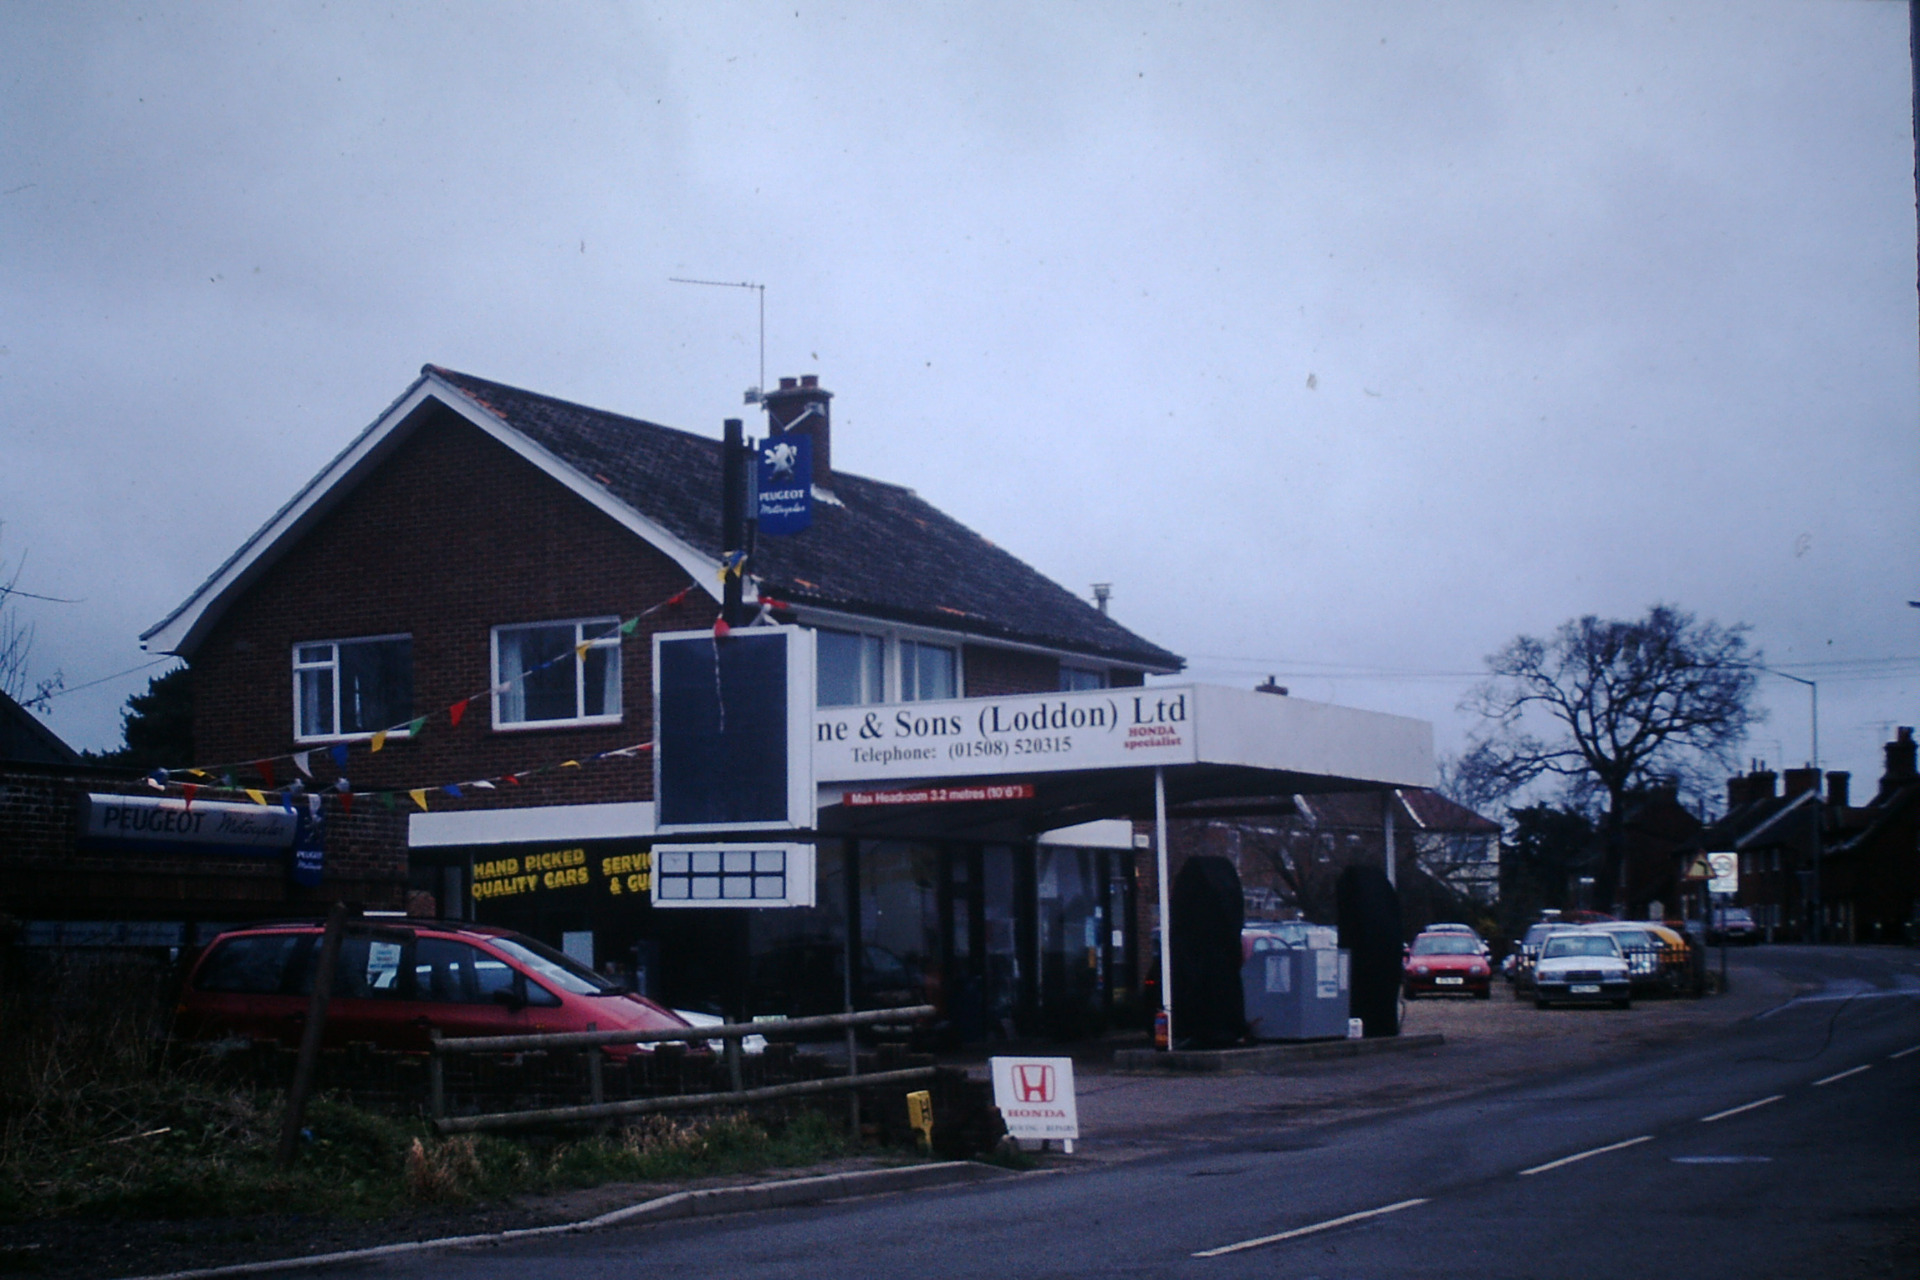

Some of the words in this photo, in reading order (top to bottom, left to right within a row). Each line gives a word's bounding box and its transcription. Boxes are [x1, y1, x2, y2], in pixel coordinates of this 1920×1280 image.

[759, 489, 804, 501] PEUGEOT
[816, 720, 849, 742] ne
[859, 711, 883, 739] &
[895, 710, 962, 738] Sons
[977, 698, 1119, 739] (Loddon)
[1132, 694, 1187, 724] Ltd
[1128, 725, 1176, 737] HONDA
[851, 745, 937, 766] Telephone:
[948, 739, 1010, 760] (01508)
[1014, 735, 1073, 754] 520315
[1123, 736, 1182, 750] specialist
[851, 793, 873, 804] Max
[875, 791, 928, 804] Headroom
[930, 789, 947, 801] 3.2
[949, 788, 985, 800] metres
[103, 806, 207, 834] PEUGEOT
[474, 858, 520, 880] HAND
[525, 849, 587, 872] PICKED
[471, 874, 540, 901] QUALITY
[544, 866, 589, 889] CARS
[610, 877, 622, 895] &
[627, 872, 653, 892] GU
[1007, 1109, 1066, 1118] HONDA
